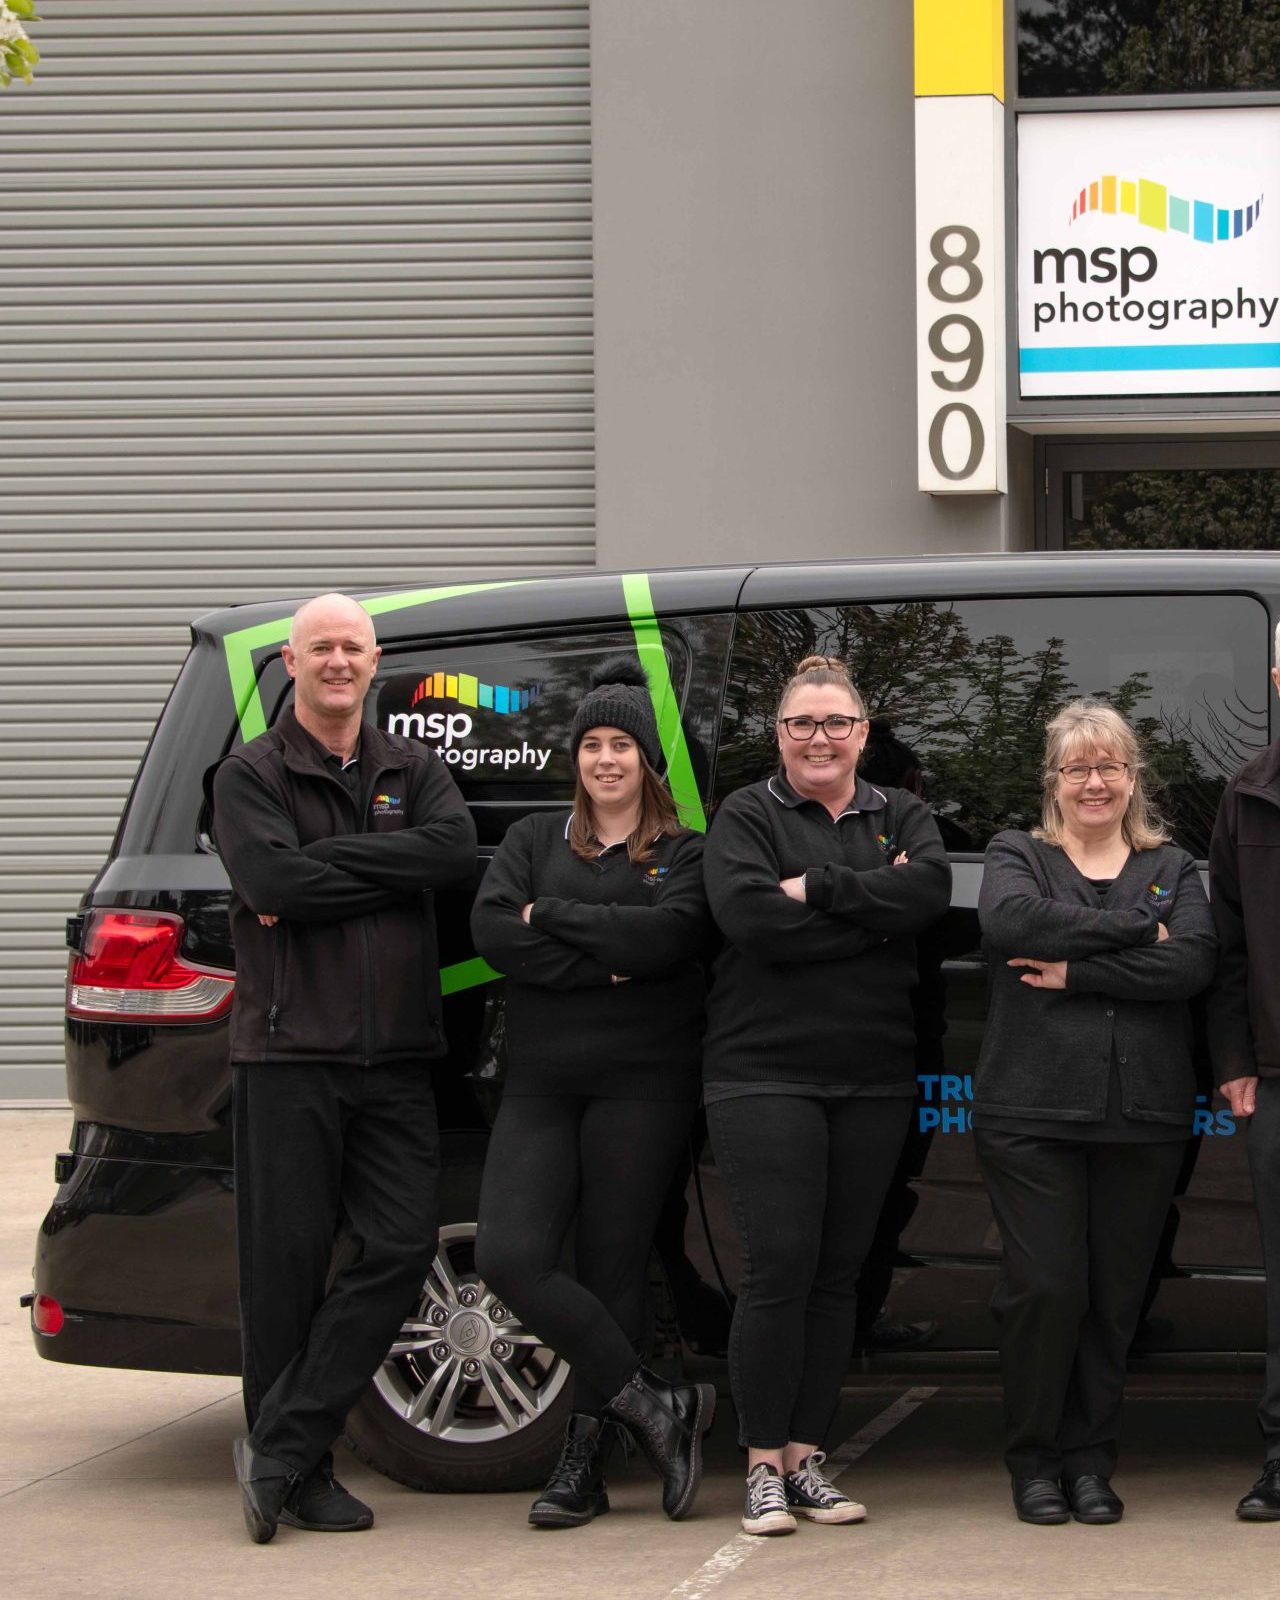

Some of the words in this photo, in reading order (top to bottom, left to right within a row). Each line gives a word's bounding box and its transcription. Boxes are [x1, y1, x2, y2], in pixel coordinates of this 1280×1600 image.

[1033, 245, 1158, 296] msp
[1034, 288, 1280, 332] photography
[928, 225, 985, 480] 890
[387, 712, 473, 748] msp
[434, 741, 552, 770] tography
